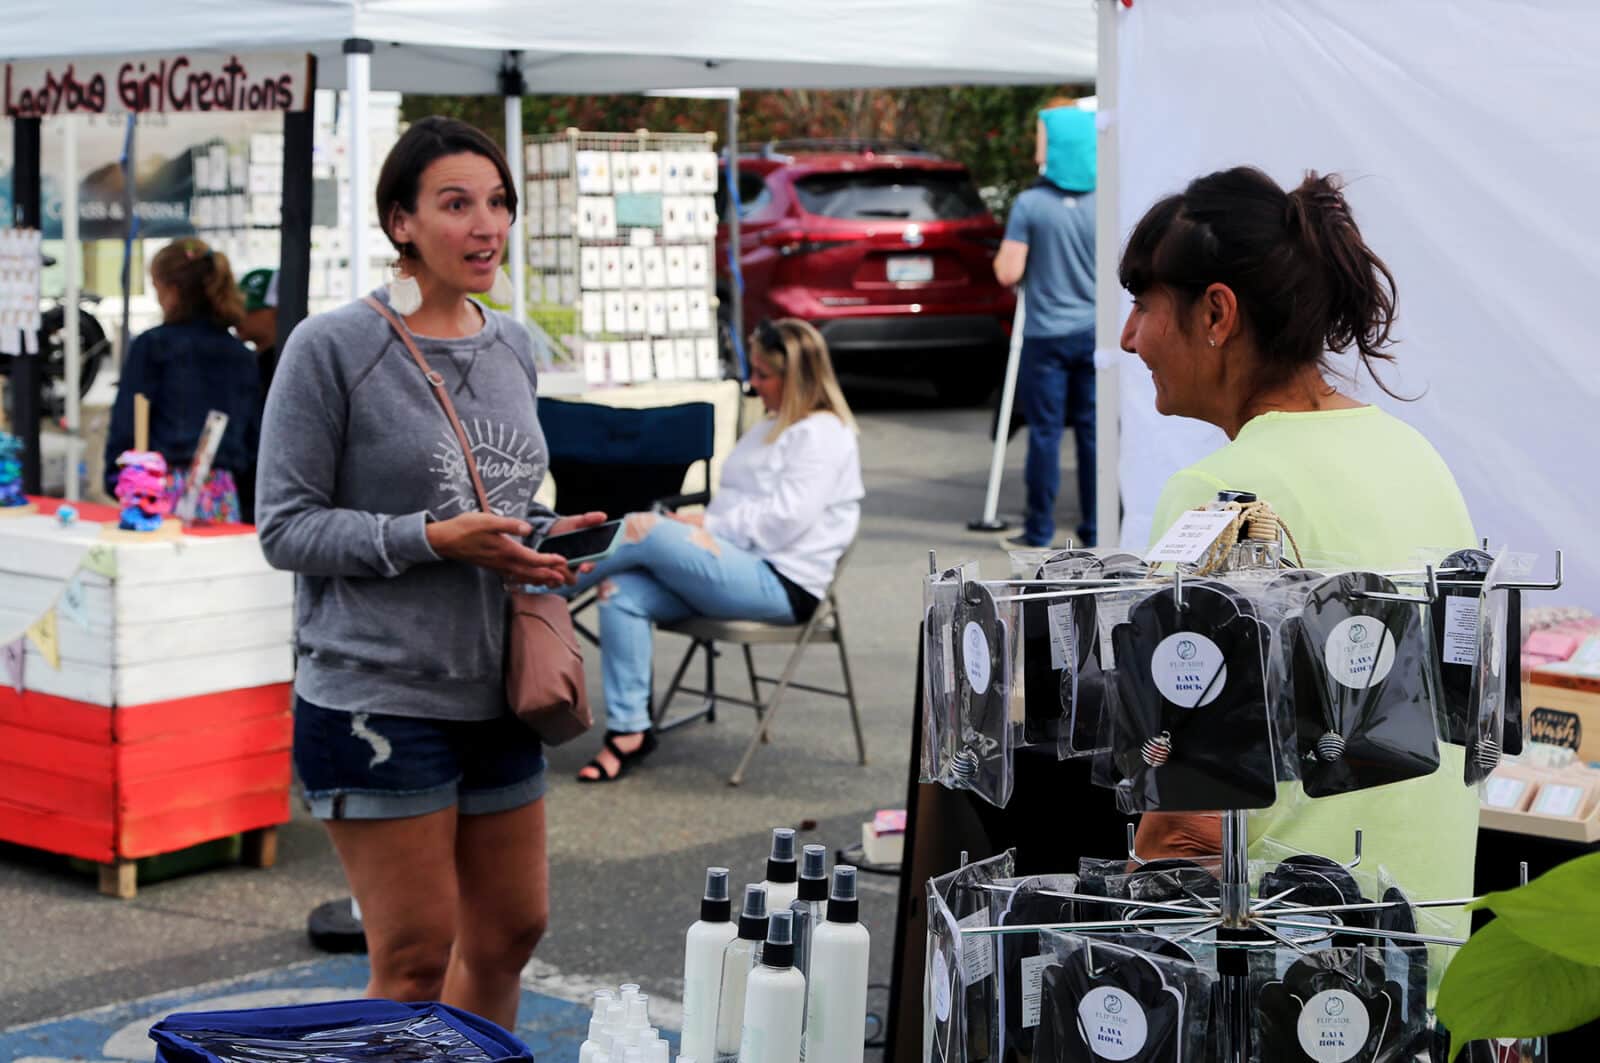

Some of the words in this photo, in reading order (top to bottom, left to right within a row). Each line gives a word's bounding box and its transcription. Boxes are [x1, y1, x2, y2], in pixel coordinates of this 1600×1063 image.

[475, 455, 544, 480] Harbor
[1100, 1025, 1122, 1037] LAVA
[1097, 1033, 1124, 1046] ROCK
[1319, 1039, 1345, 1047] ROCK
